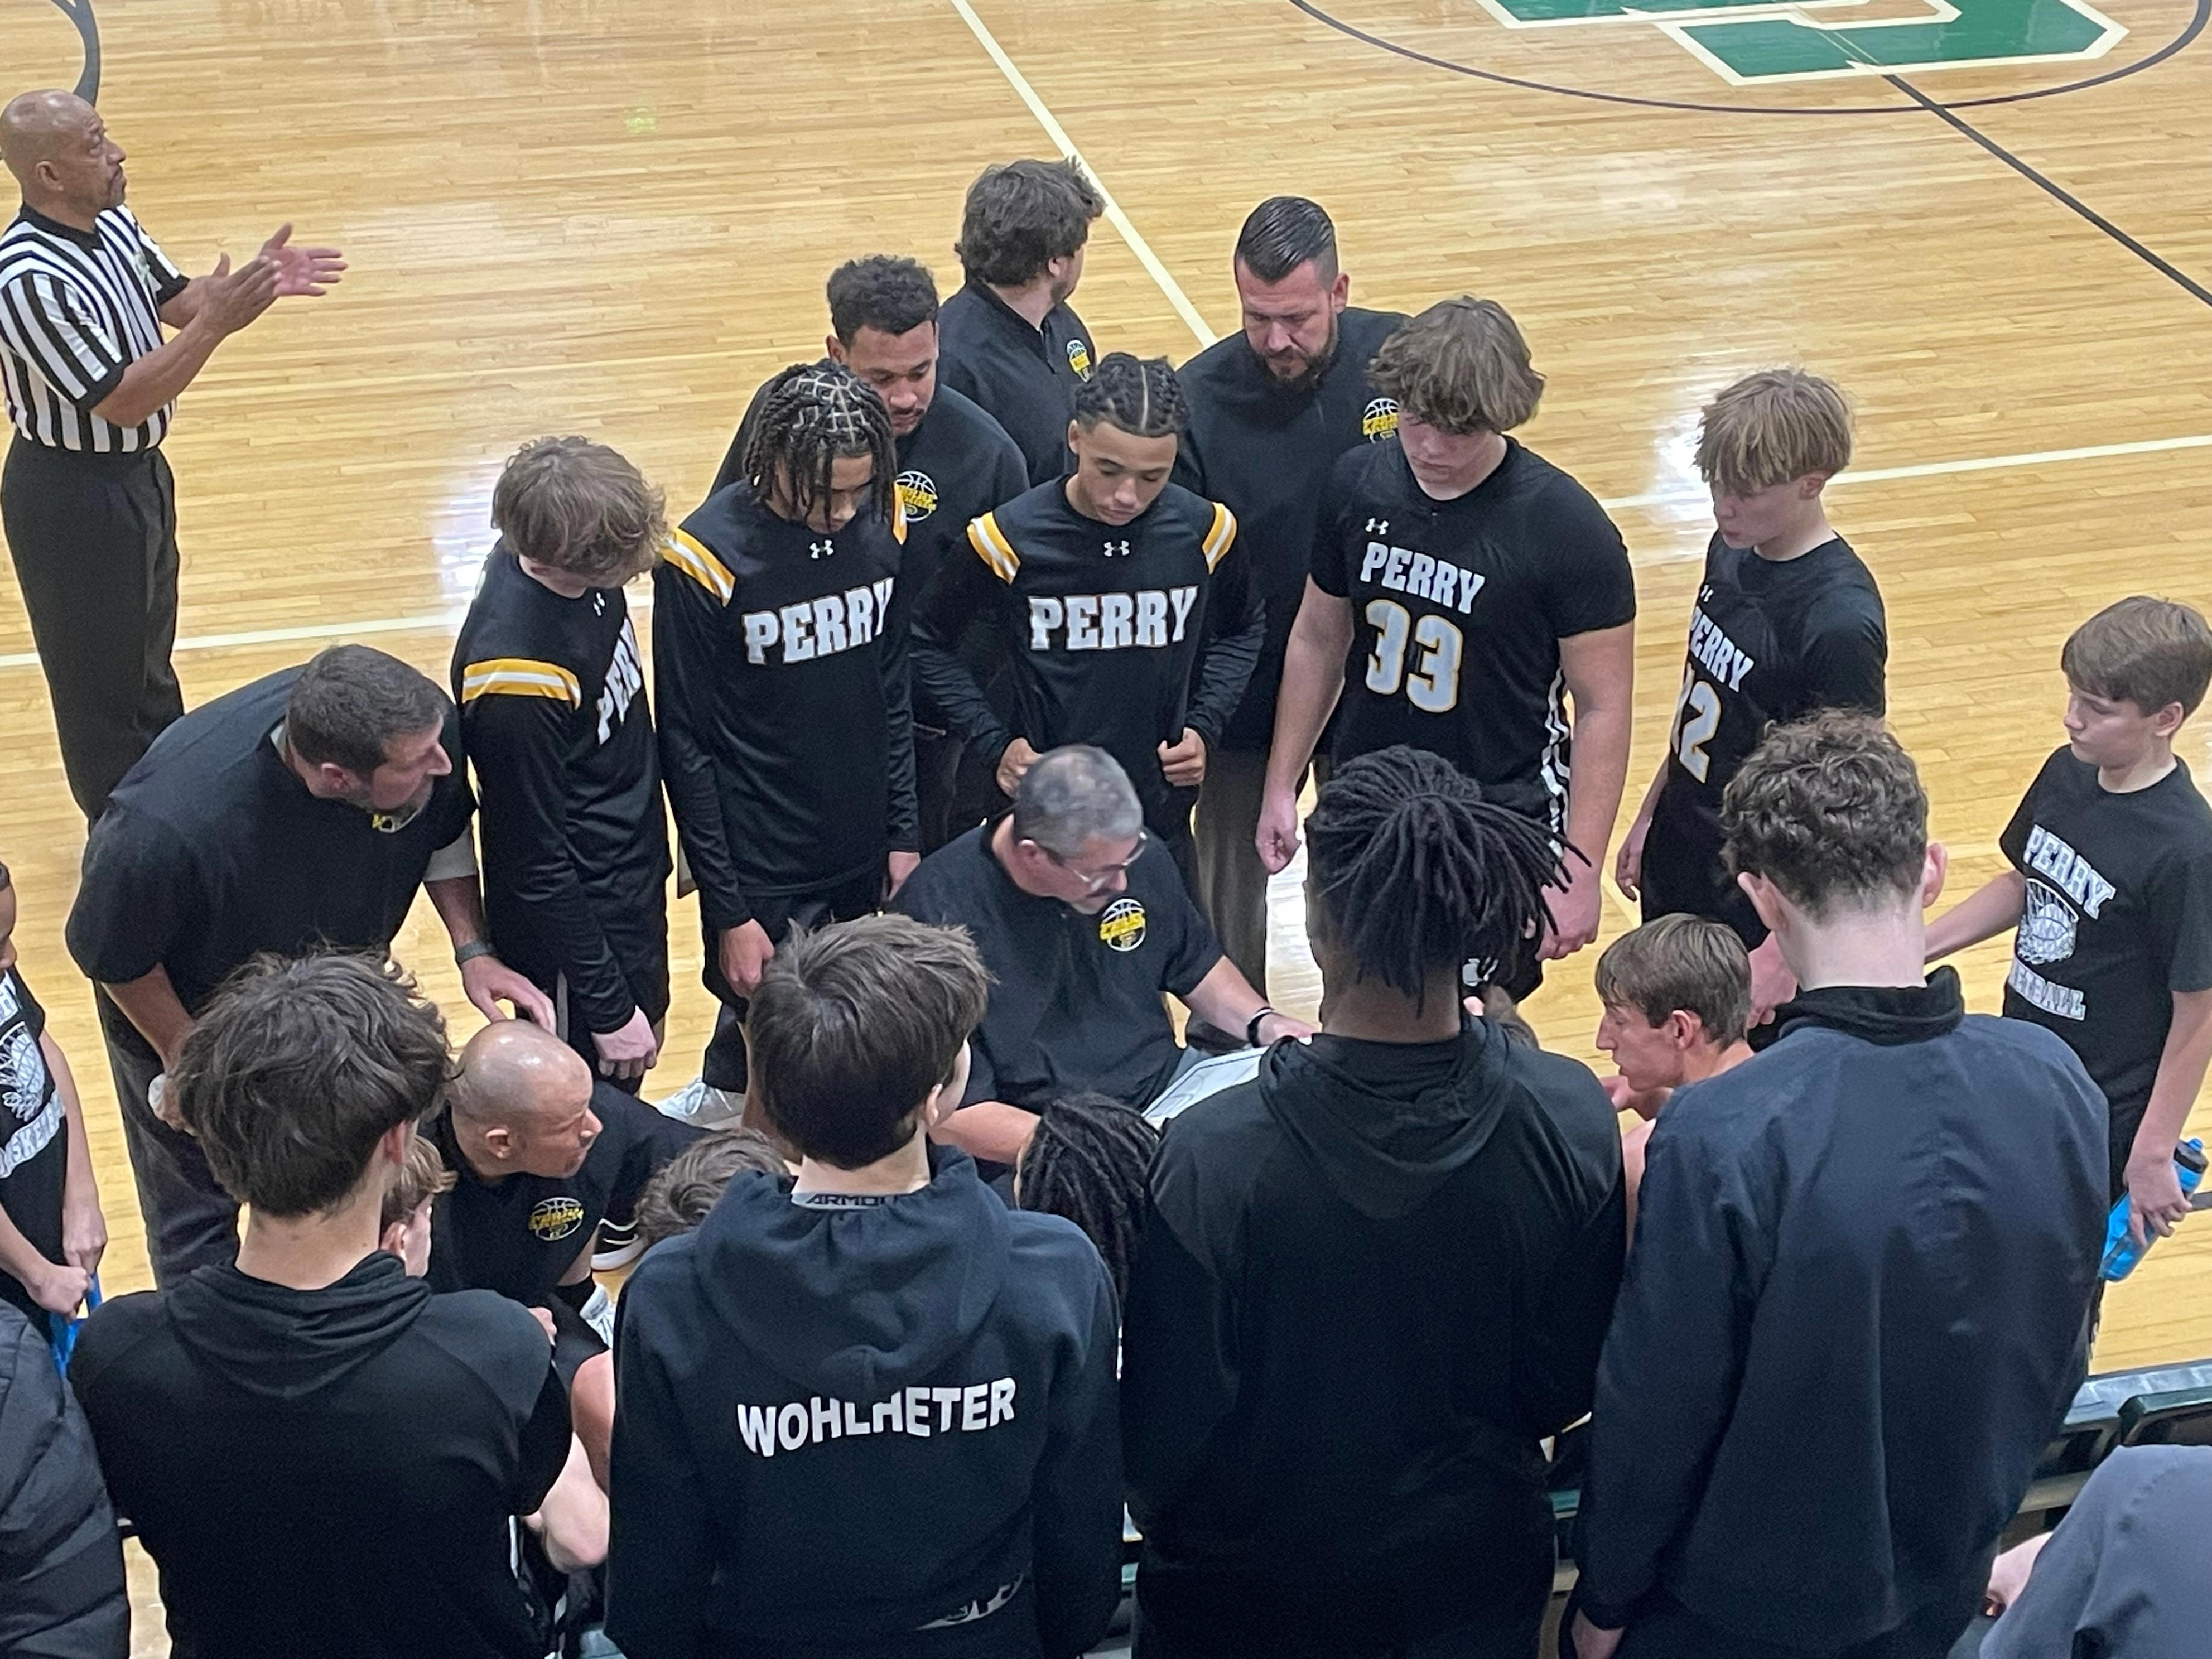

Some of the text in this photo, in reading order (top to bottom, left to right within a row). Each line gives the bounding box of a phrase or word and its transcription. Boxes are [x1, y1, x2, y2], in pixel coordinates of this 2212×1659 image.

[1028, 585, 1199, 650] PERRY
[1360, 541, 1486, 614] PERRY
[741, 577, 895, 665] PERRY
[1365, 598, 1463, 713] 33
[2023, 824, 2117, 920] PERRY
[805, 1193, 886, 1207] ARMO
[737, 1377, 1017, 1458] WOHLHETER
